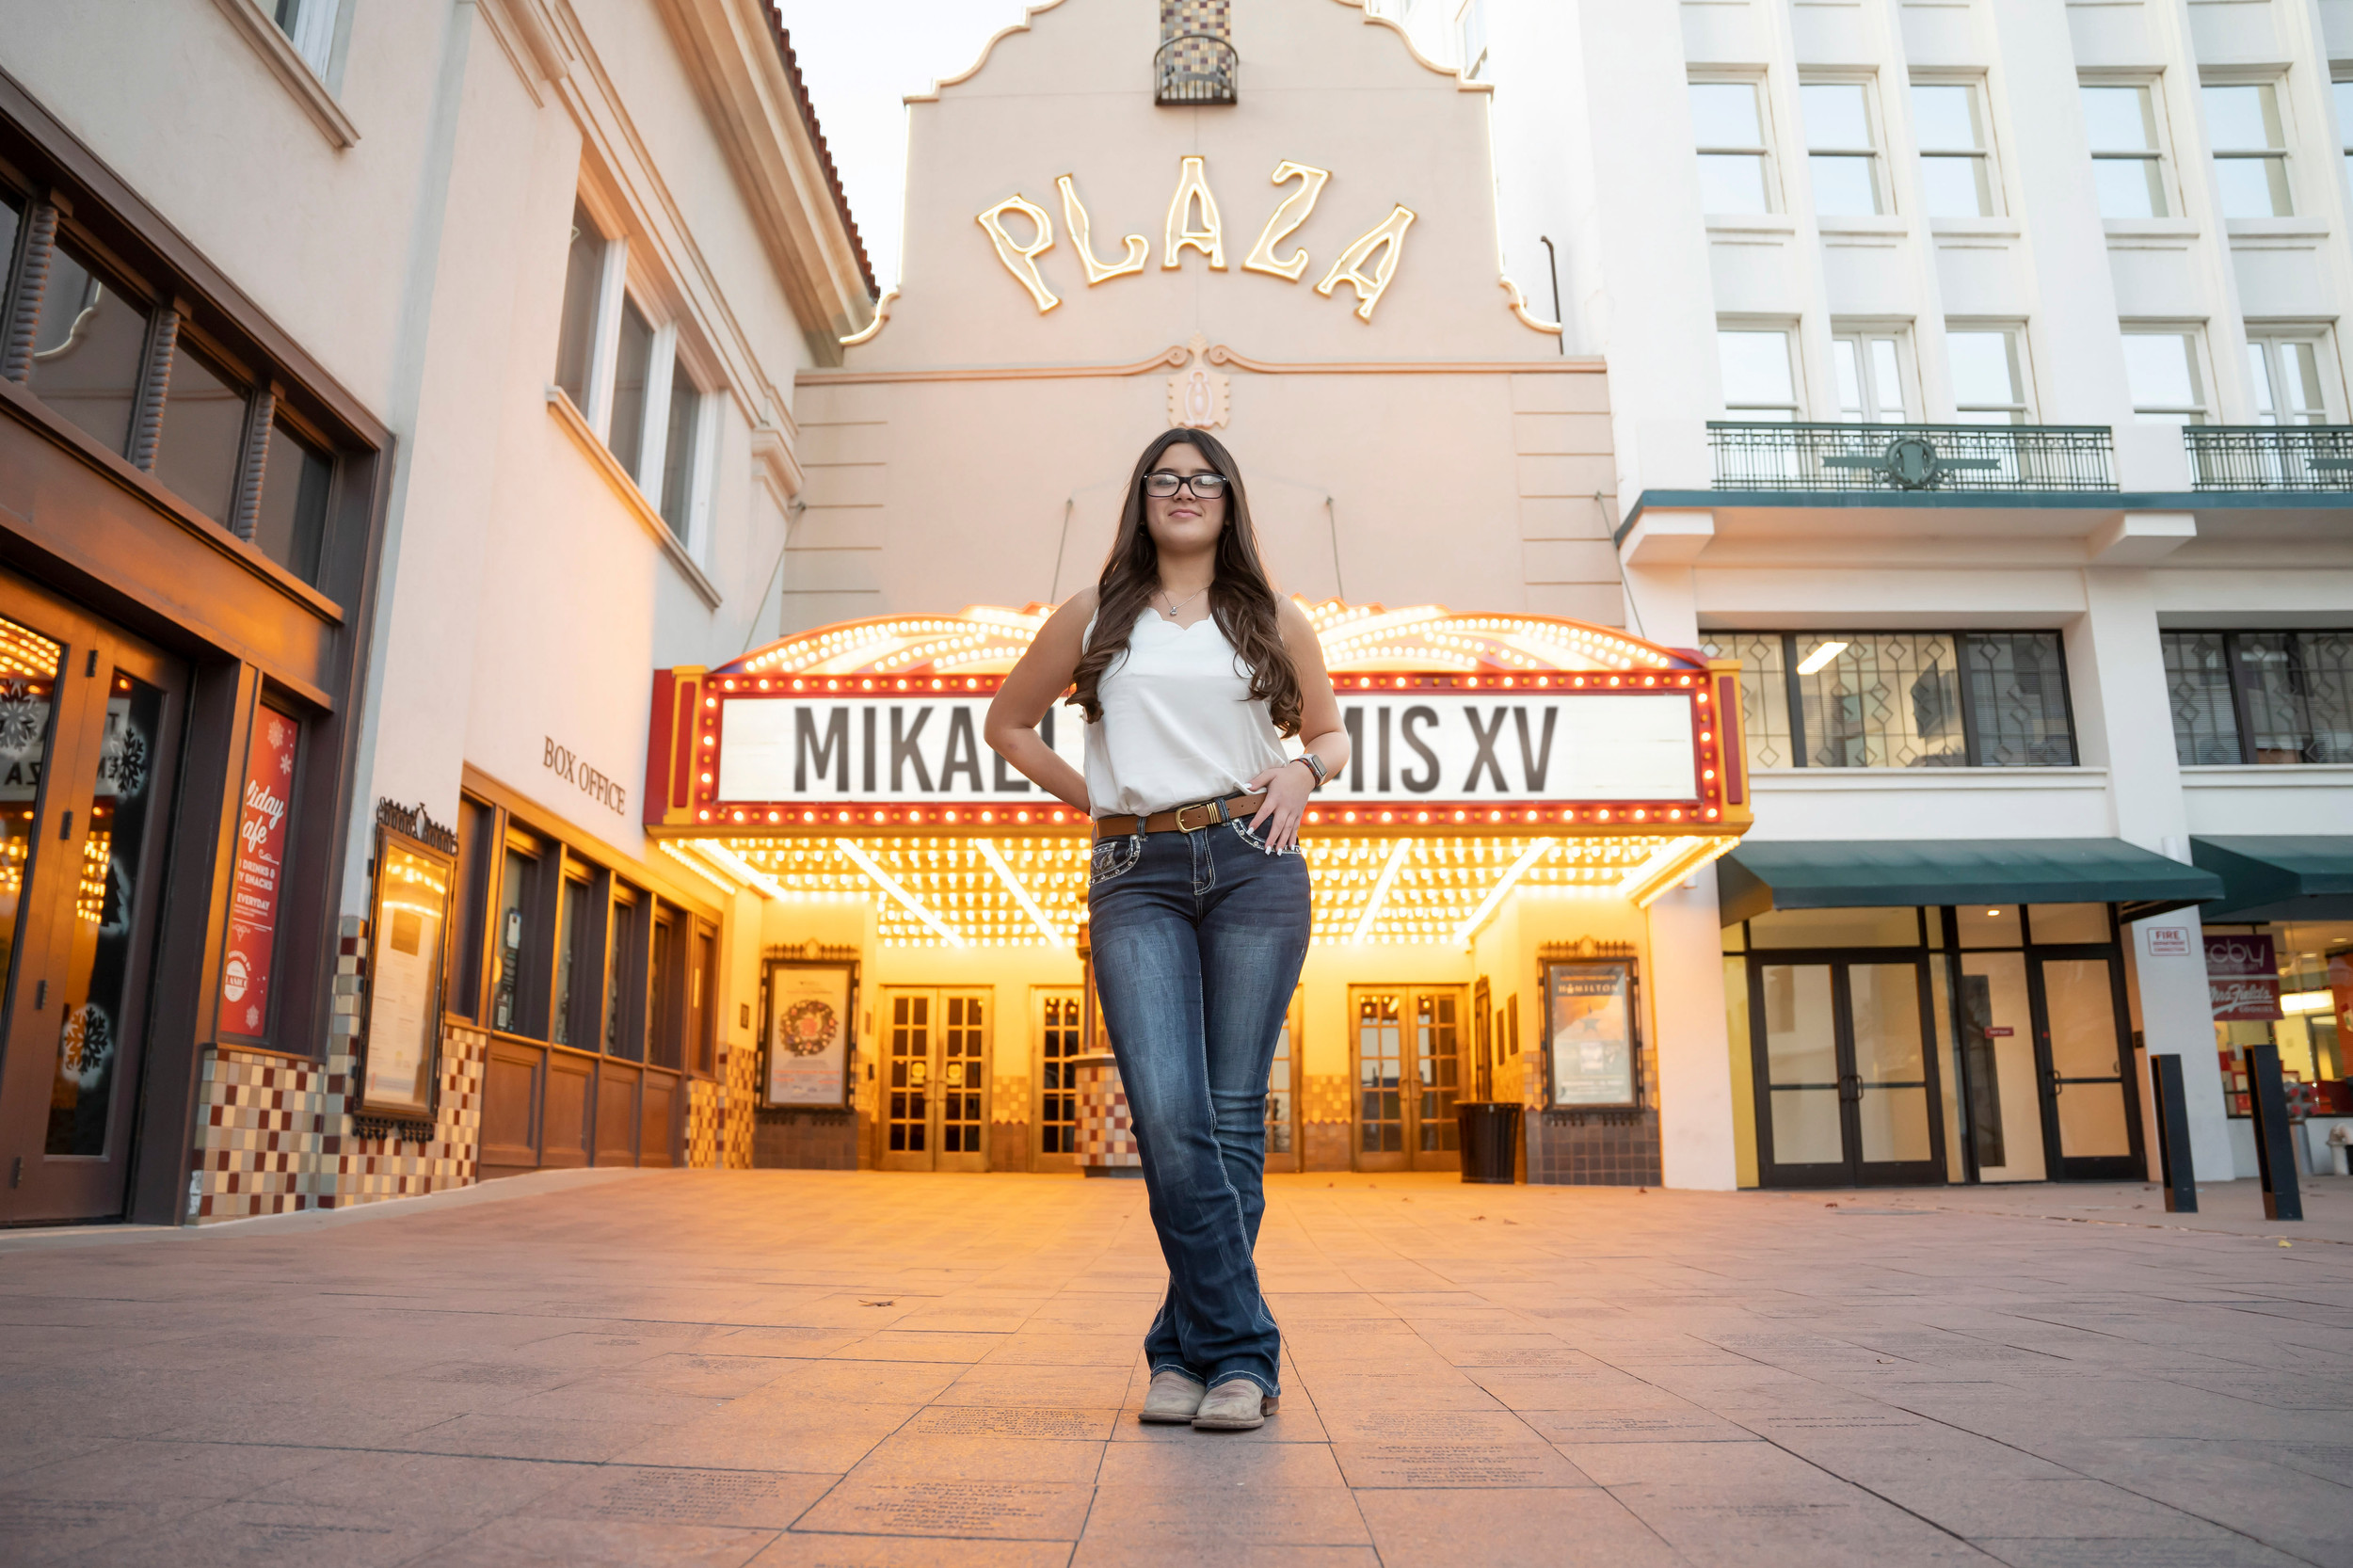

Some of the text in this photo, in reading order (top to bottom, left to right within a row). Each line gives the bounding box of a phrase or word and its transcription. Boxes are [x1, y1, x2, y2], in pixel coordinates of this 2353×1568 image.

[975, 155, 1417, 323] PLAZA
[543, 735, 625, 816] BOX OFFICE
[1462, 706, 1559, 792] XV
[242, 814, 267, 854] afe
[236, 892, 270, 911] EVERYDAY
[2155, 930, 2181, 940] FIRE
